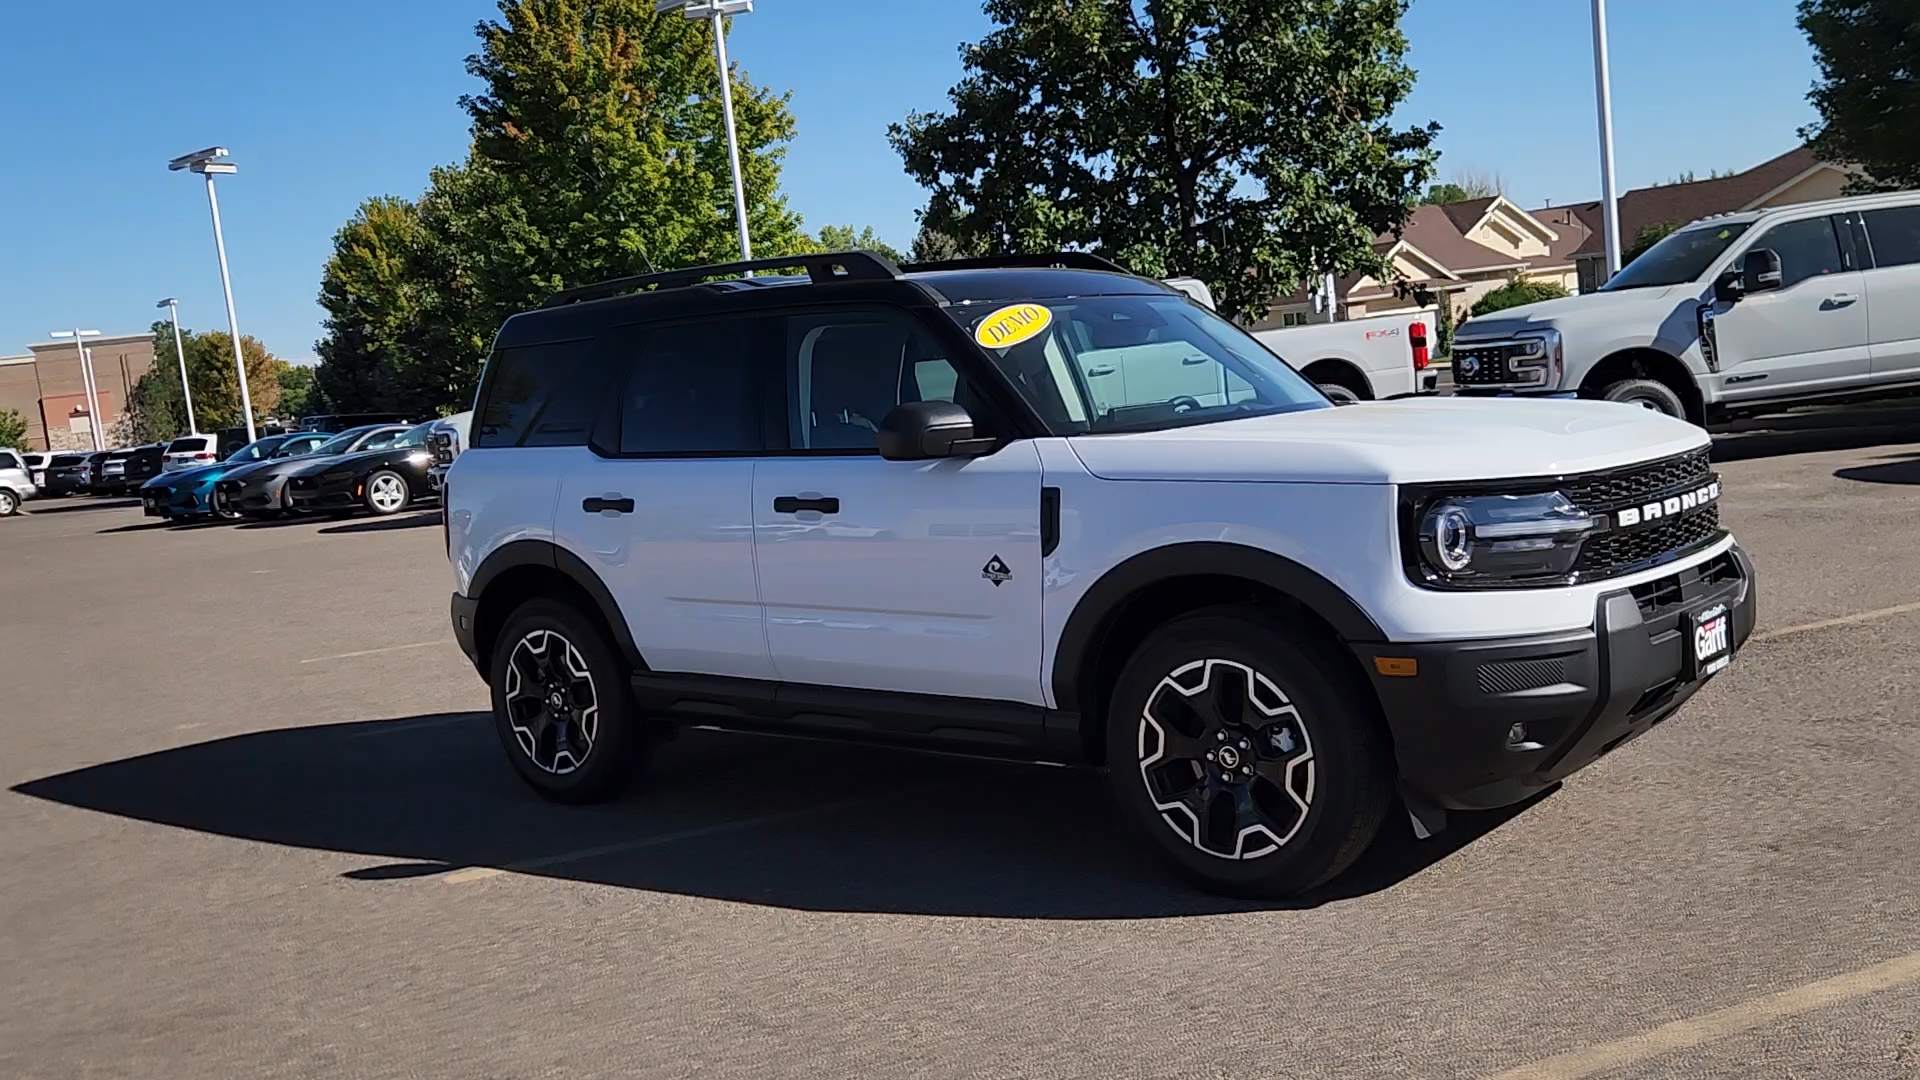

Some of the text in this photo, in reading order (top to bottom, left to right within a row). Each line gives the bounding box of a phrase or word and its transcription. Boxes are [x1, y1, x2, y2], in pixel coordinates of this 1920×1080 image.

[988, 307, 1040, 342] DEMO
[1365, 328, 1400, 340] FX4
[1618, 482, 1719, 526] BRONCO
[1695, 615, 1727, 660] Garff
